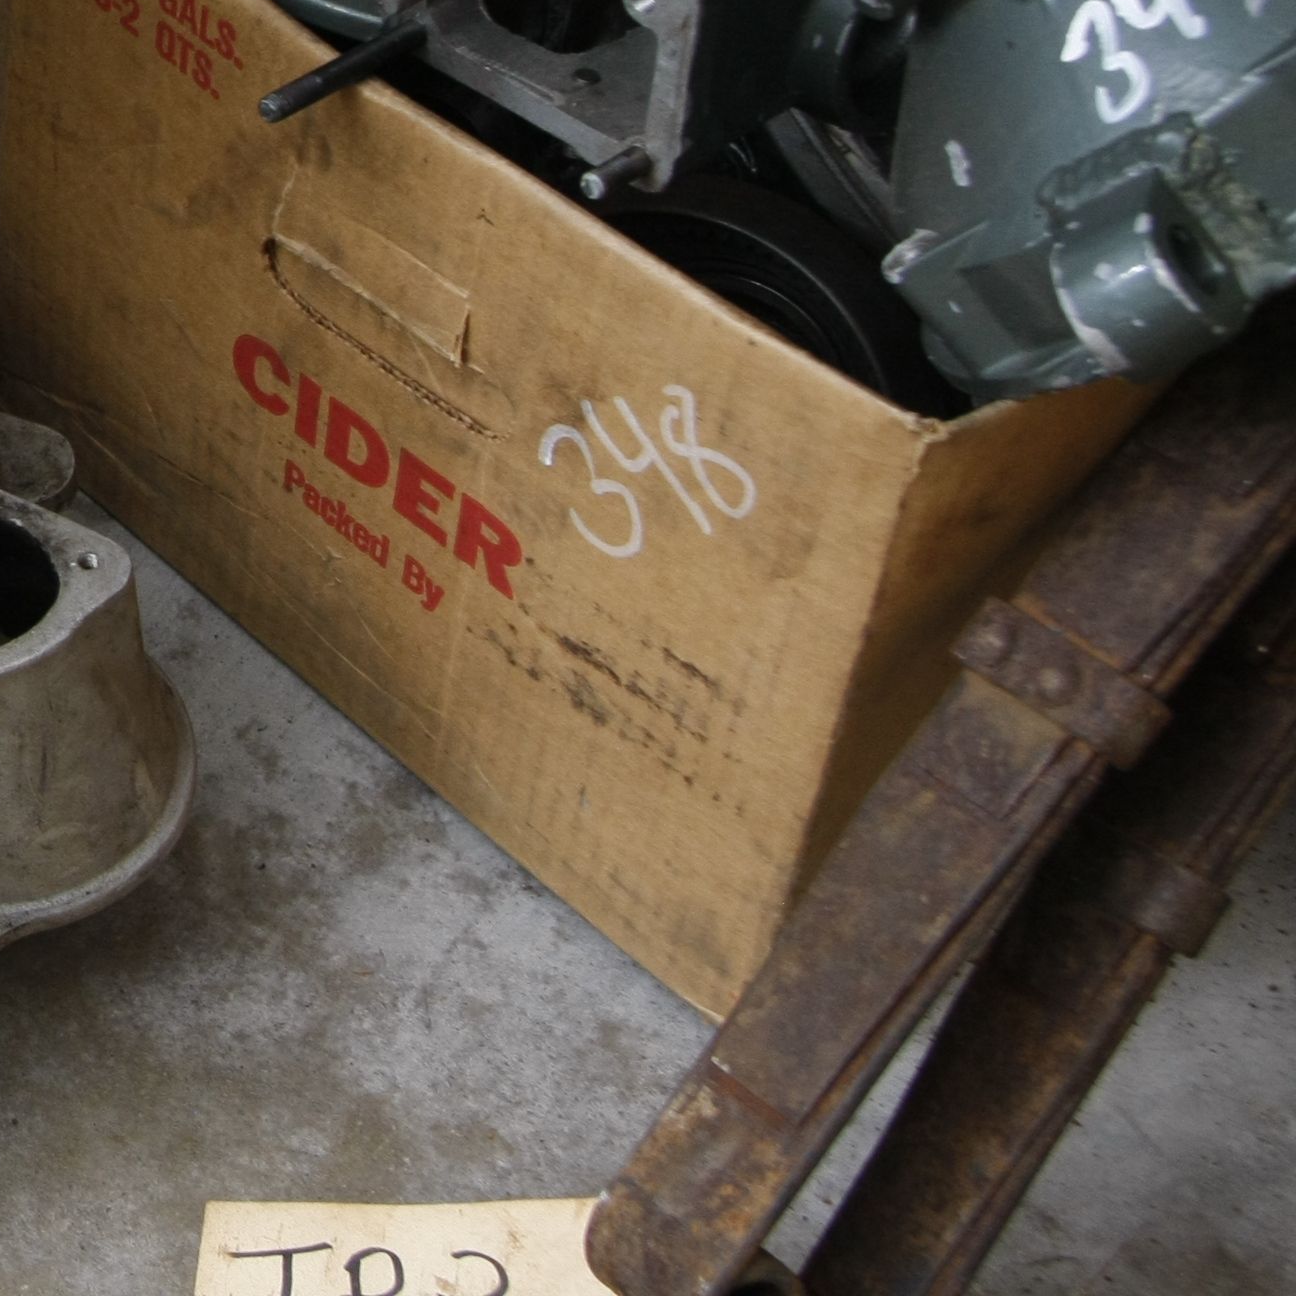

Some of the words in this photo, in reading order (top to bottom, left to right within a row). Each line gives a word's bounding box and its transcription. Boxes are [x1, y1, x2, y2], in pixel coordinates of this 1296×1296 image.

[154, 20, 221, 101] QTS.
[231, 333, 525, 602] CIDER
[283, 458, 390, 570] Packed
[401, 553, 447, 613] By
[537, 384, 757, 559] 348
